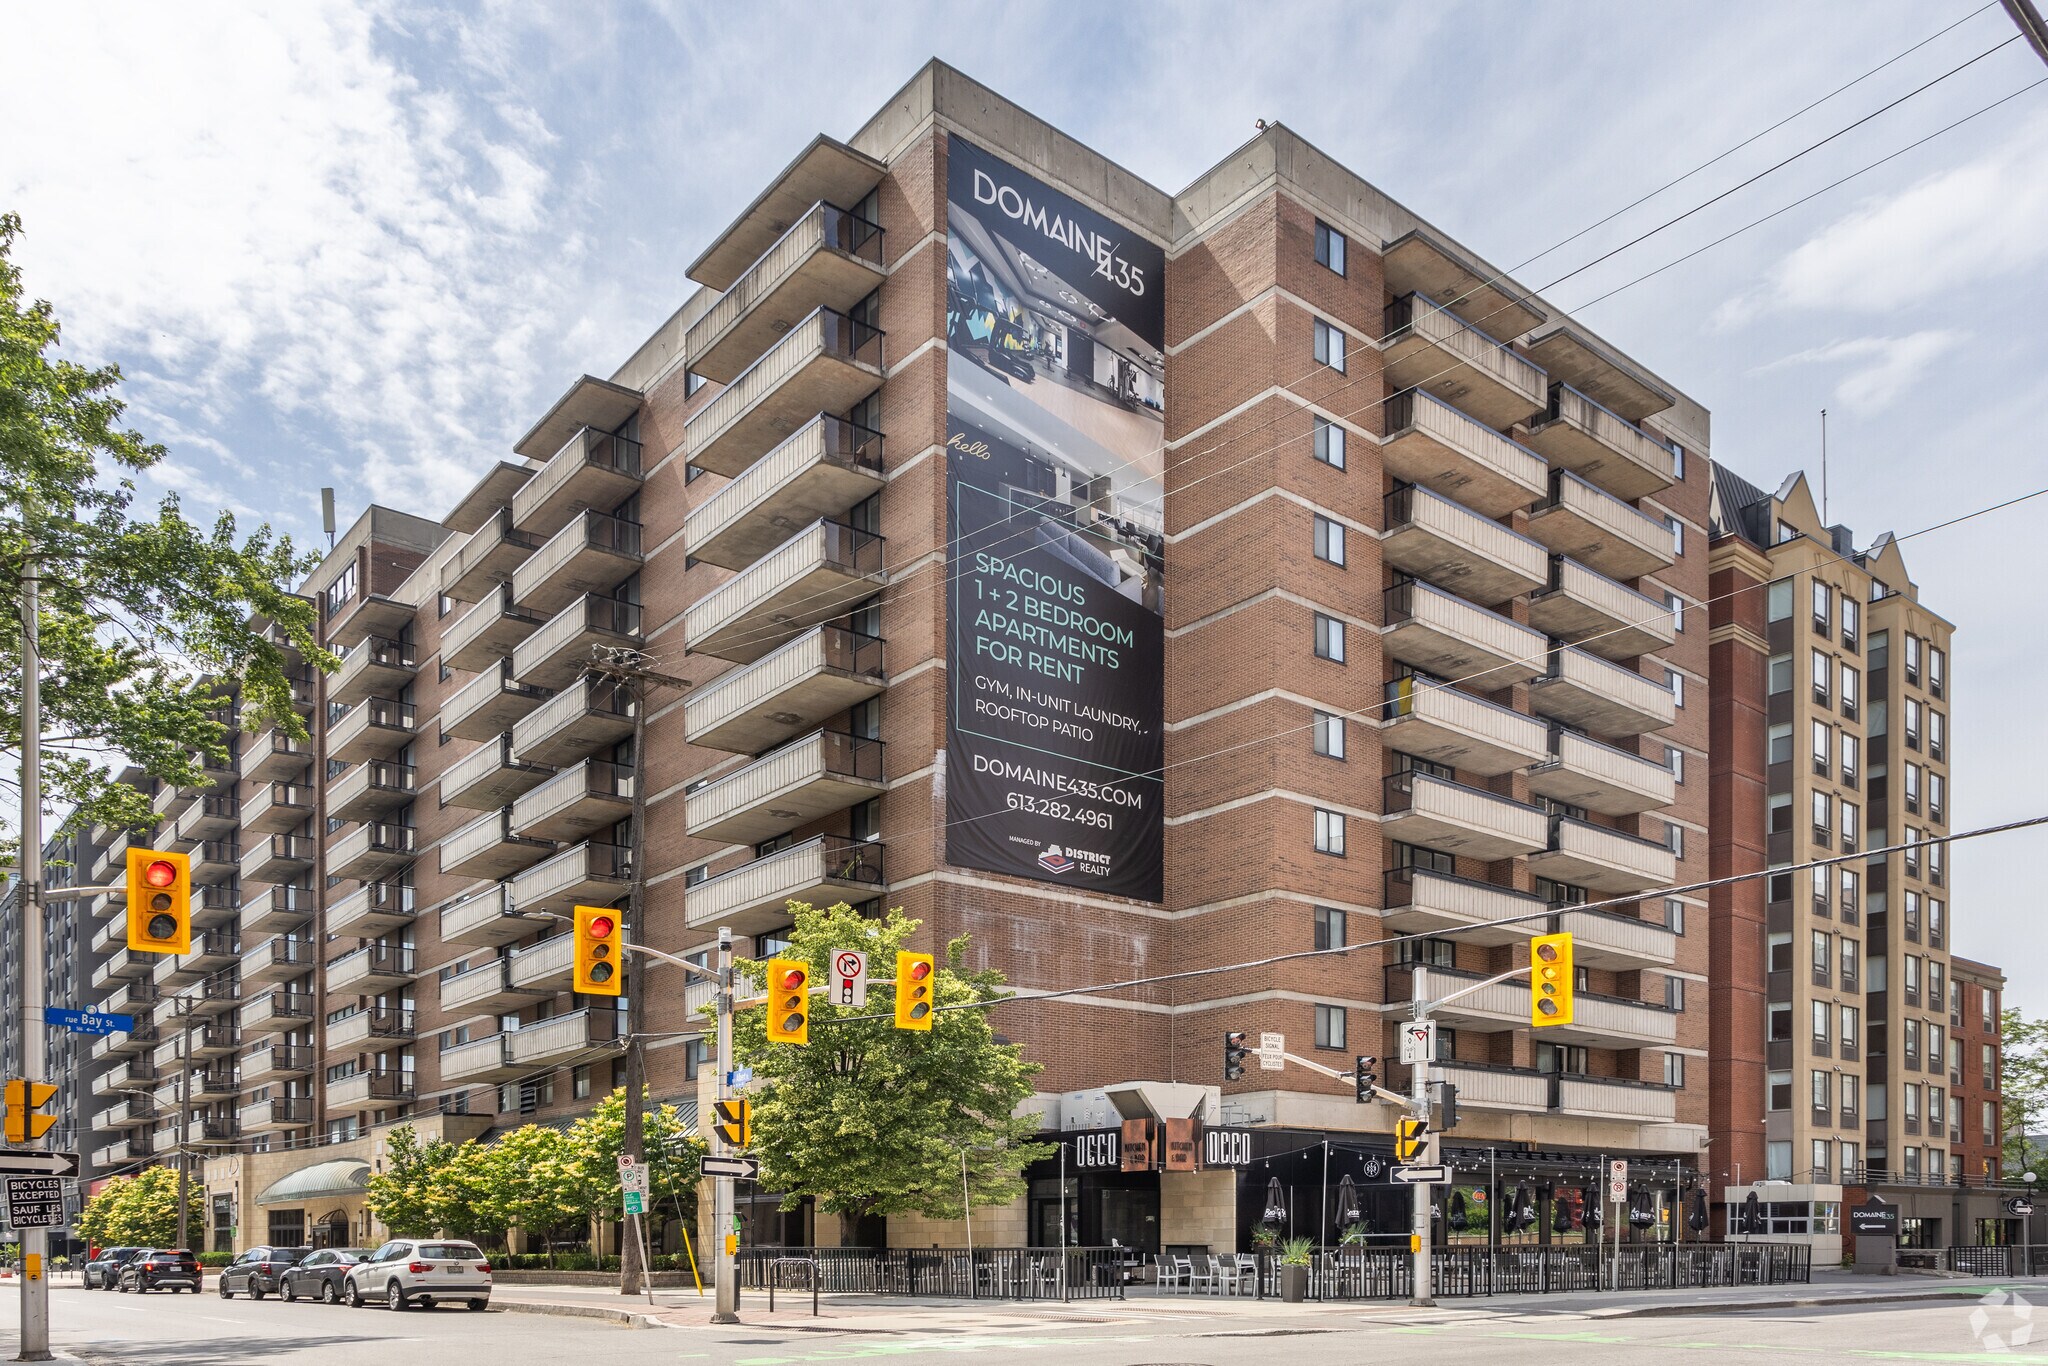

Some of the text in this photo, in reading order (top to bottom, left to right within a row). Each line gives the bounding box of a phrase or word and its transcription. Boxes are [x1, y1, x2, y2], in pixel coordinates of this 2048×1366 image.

[946, 432, 990, 460] hello
[975, 552, 1085, 606] SPACIOUS
[974, 579, 1134, 648] 1 + 2 BEDROOM
[974, 609, 1119, 669] APARTMENTS
[976, 636, 1084, 684] FOR RENT
[975, 675, 1141, 735] GYM, IN-UNIT LAUNDRY,
[975, 699, 1093, 742] ROOFTOP PATIO
[974, 754, 1142, 809] DOMAINE435.COM
[1006, 792, 1112, 830] 613.282.4961
[1009, 836, 1034, 846] MANAGED
[1065, 847, 1111, 865] DISTRICT
[1080, 862, 1110, 877] REALTY
[82, 1014, 102, 1028] Bay
[11, 1180, 59, 1190] BICYCLES
[12, 1191, 59, 1200] EXCEPTED
[13, 1206, 40, 1214] SAUF
